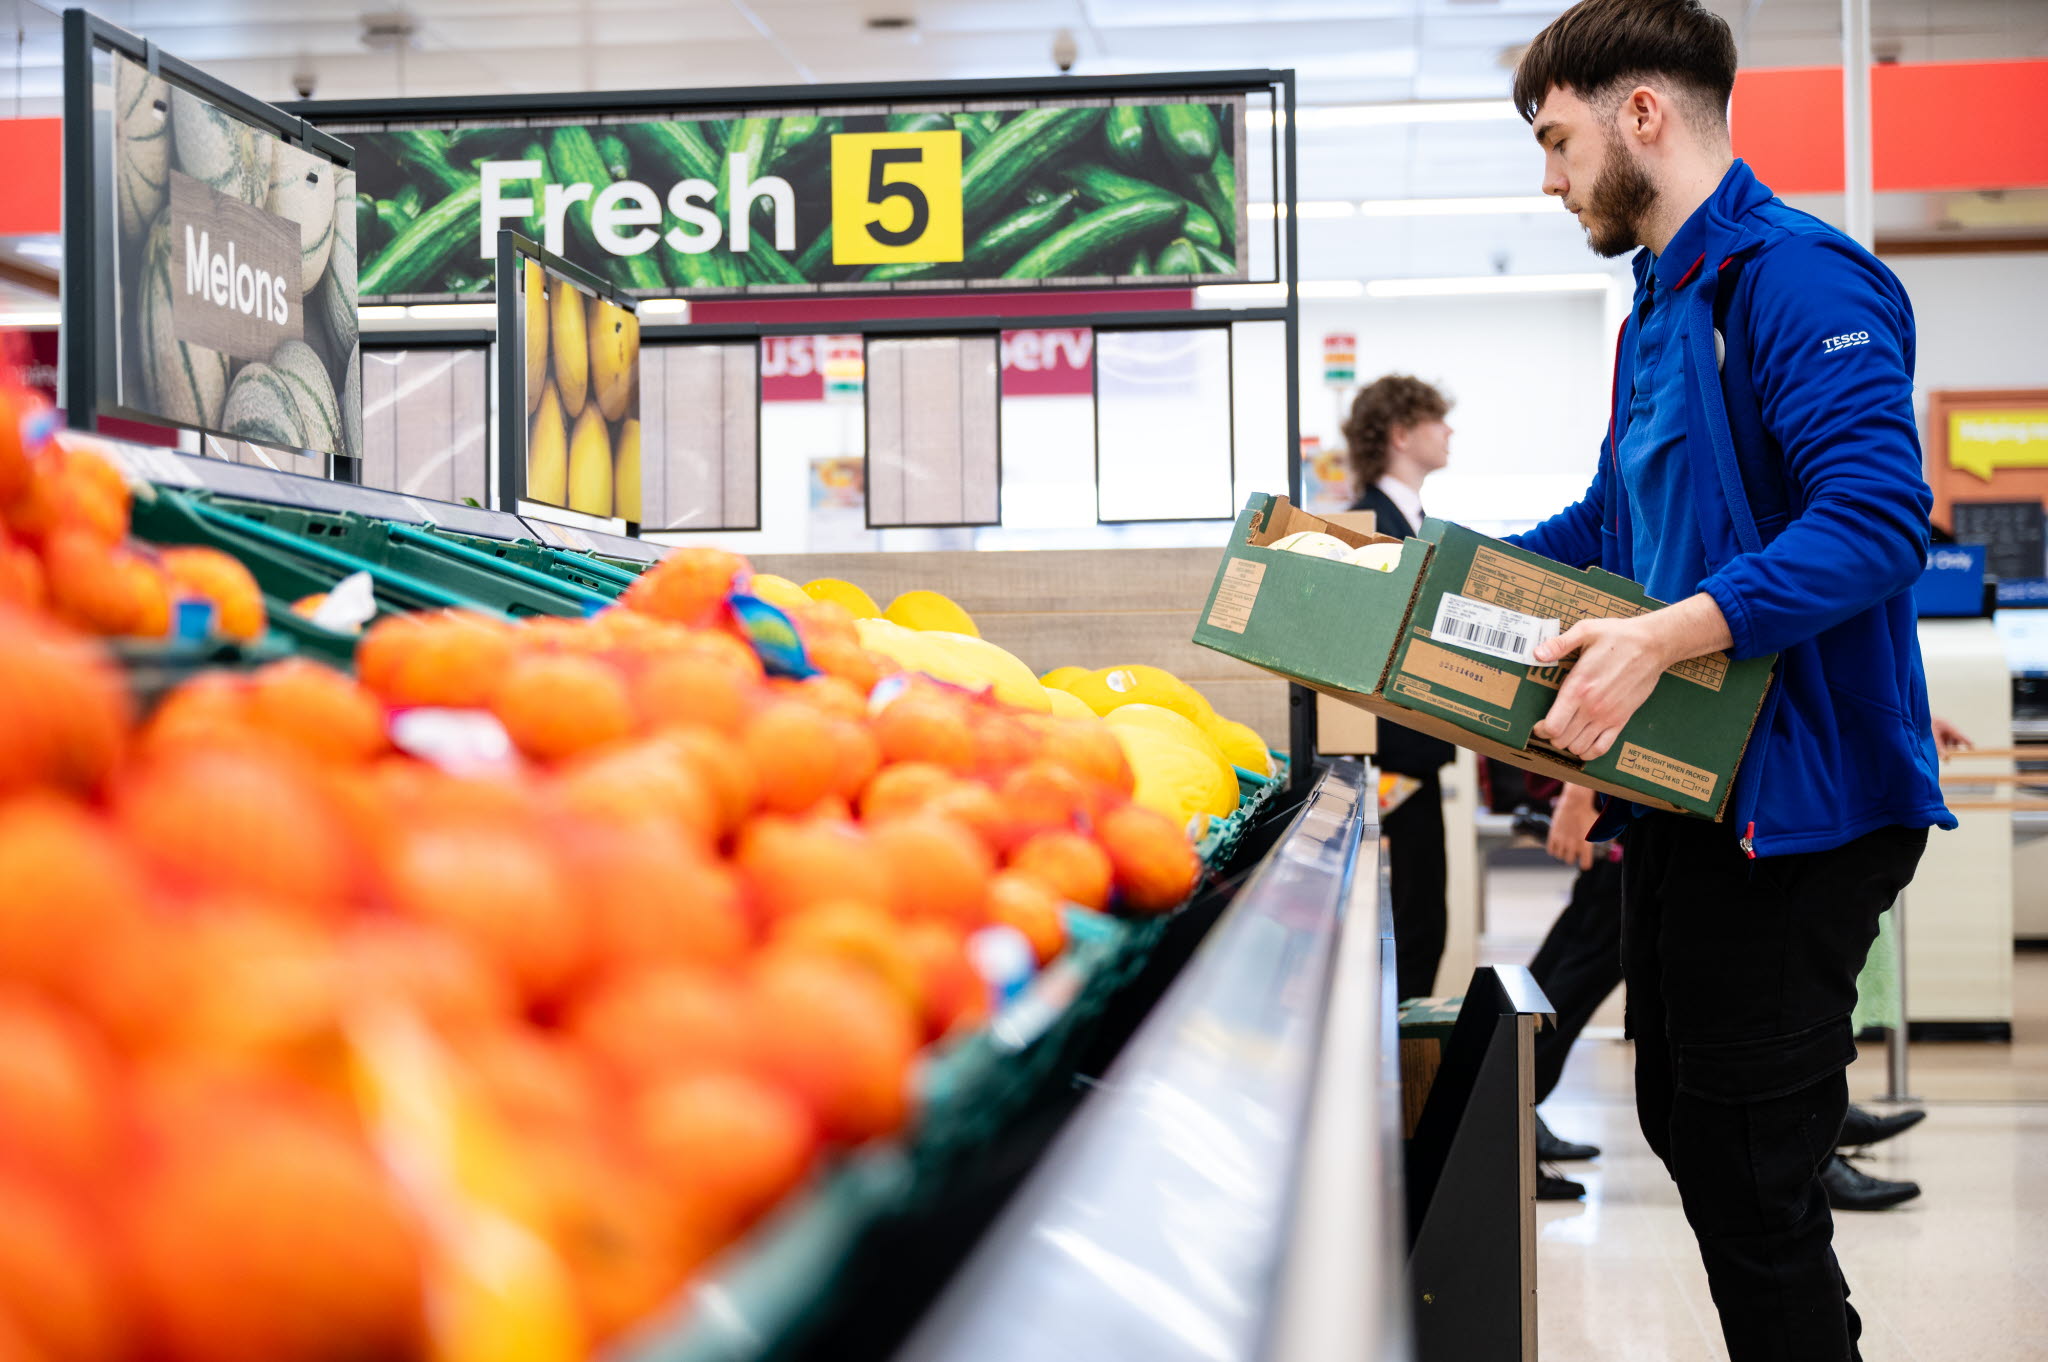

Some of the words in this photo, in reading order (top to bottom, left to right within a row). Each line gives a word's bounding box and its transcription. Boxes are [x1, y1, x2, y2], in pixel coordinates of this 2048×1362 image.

[480, 153, 797, 259] Fresh
[863, 147, 930, 247] 5
[185, 224, 289, 326] Melons
[1822, 331, 1869, 348] TESCO
[1628, 748, 1641, 757] NET
[1642, 753, 1666, 767] WEIGHT
[1666, 762, 1685, 773] WHEN
[1685, 769, 1710, 783] PACKED
[1641, 765, 1650, 773] KG
[1671, 776, 1680, 784] KG
[1701, 787, 1710, 795] KG
